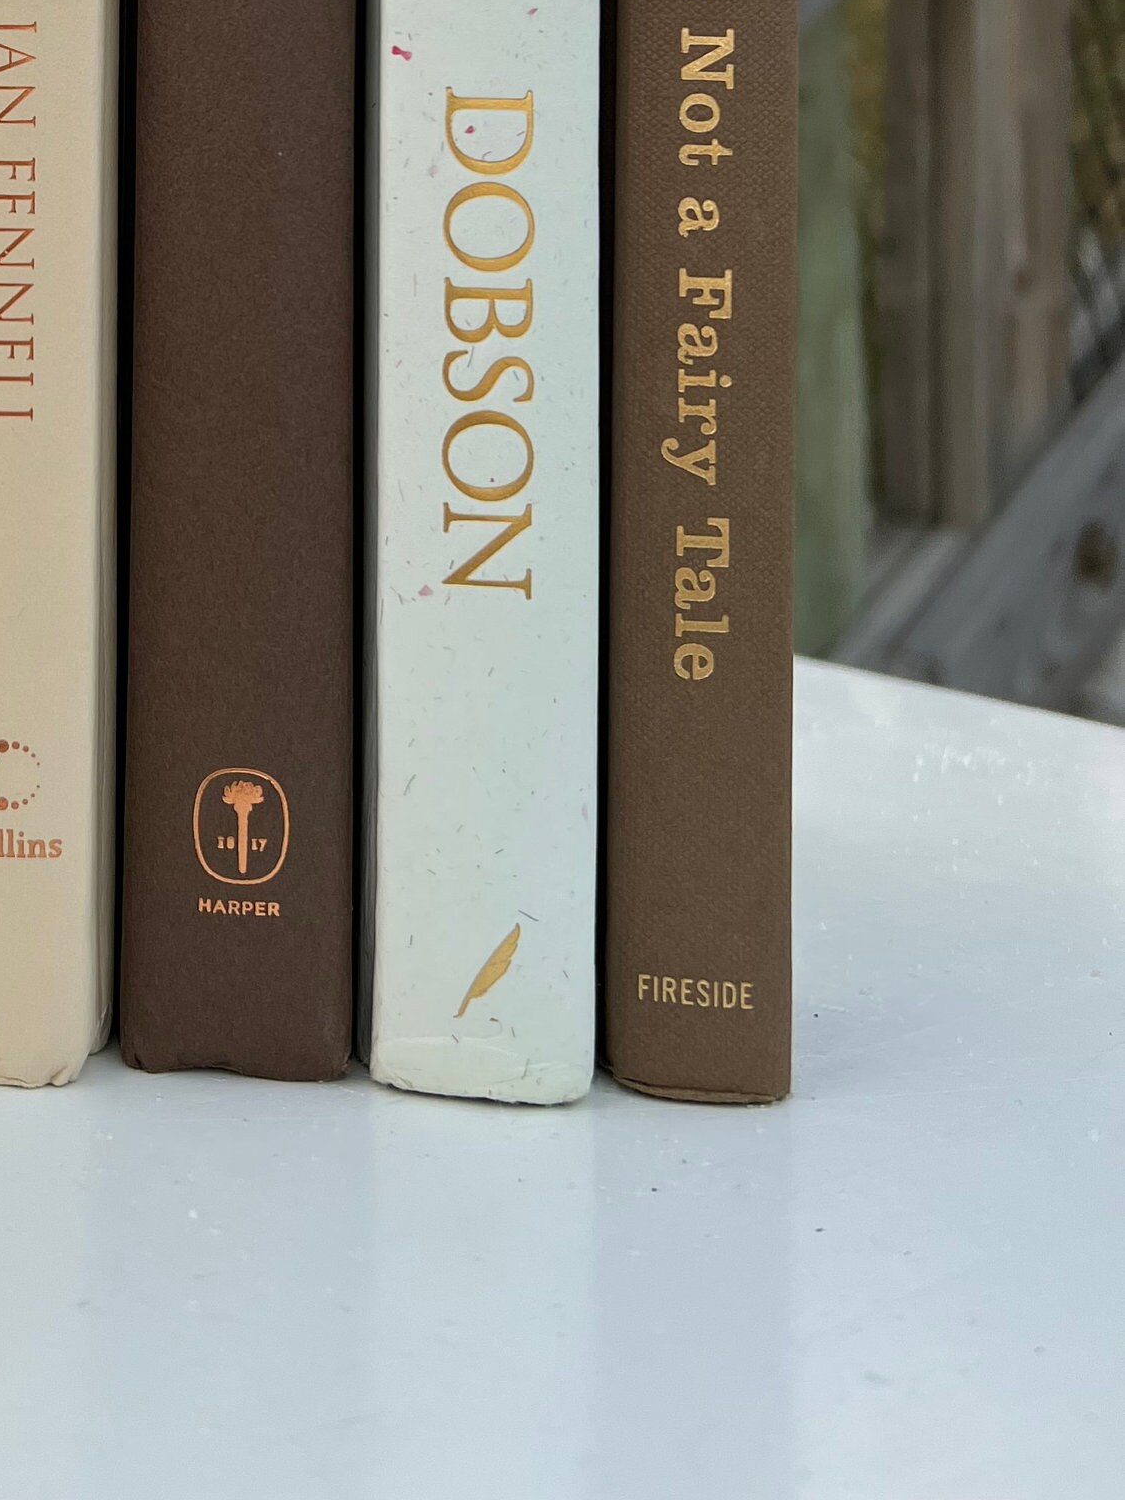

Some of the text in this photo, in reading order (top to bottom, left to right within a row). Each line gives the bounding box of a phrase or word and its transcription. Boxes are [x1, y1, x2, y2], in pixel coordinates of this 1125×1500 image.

[678, 24, 736, 169] Not
[678, 197, 720, 237] a
[442, 87, 533, 601] DOBSON
[661, 267, 733, 488] Fairy
[671, 513, 732, 684] Tale
[197, 897, 281, 917] HARPER
[637, 973, 755, 1010] FIRESIDE
